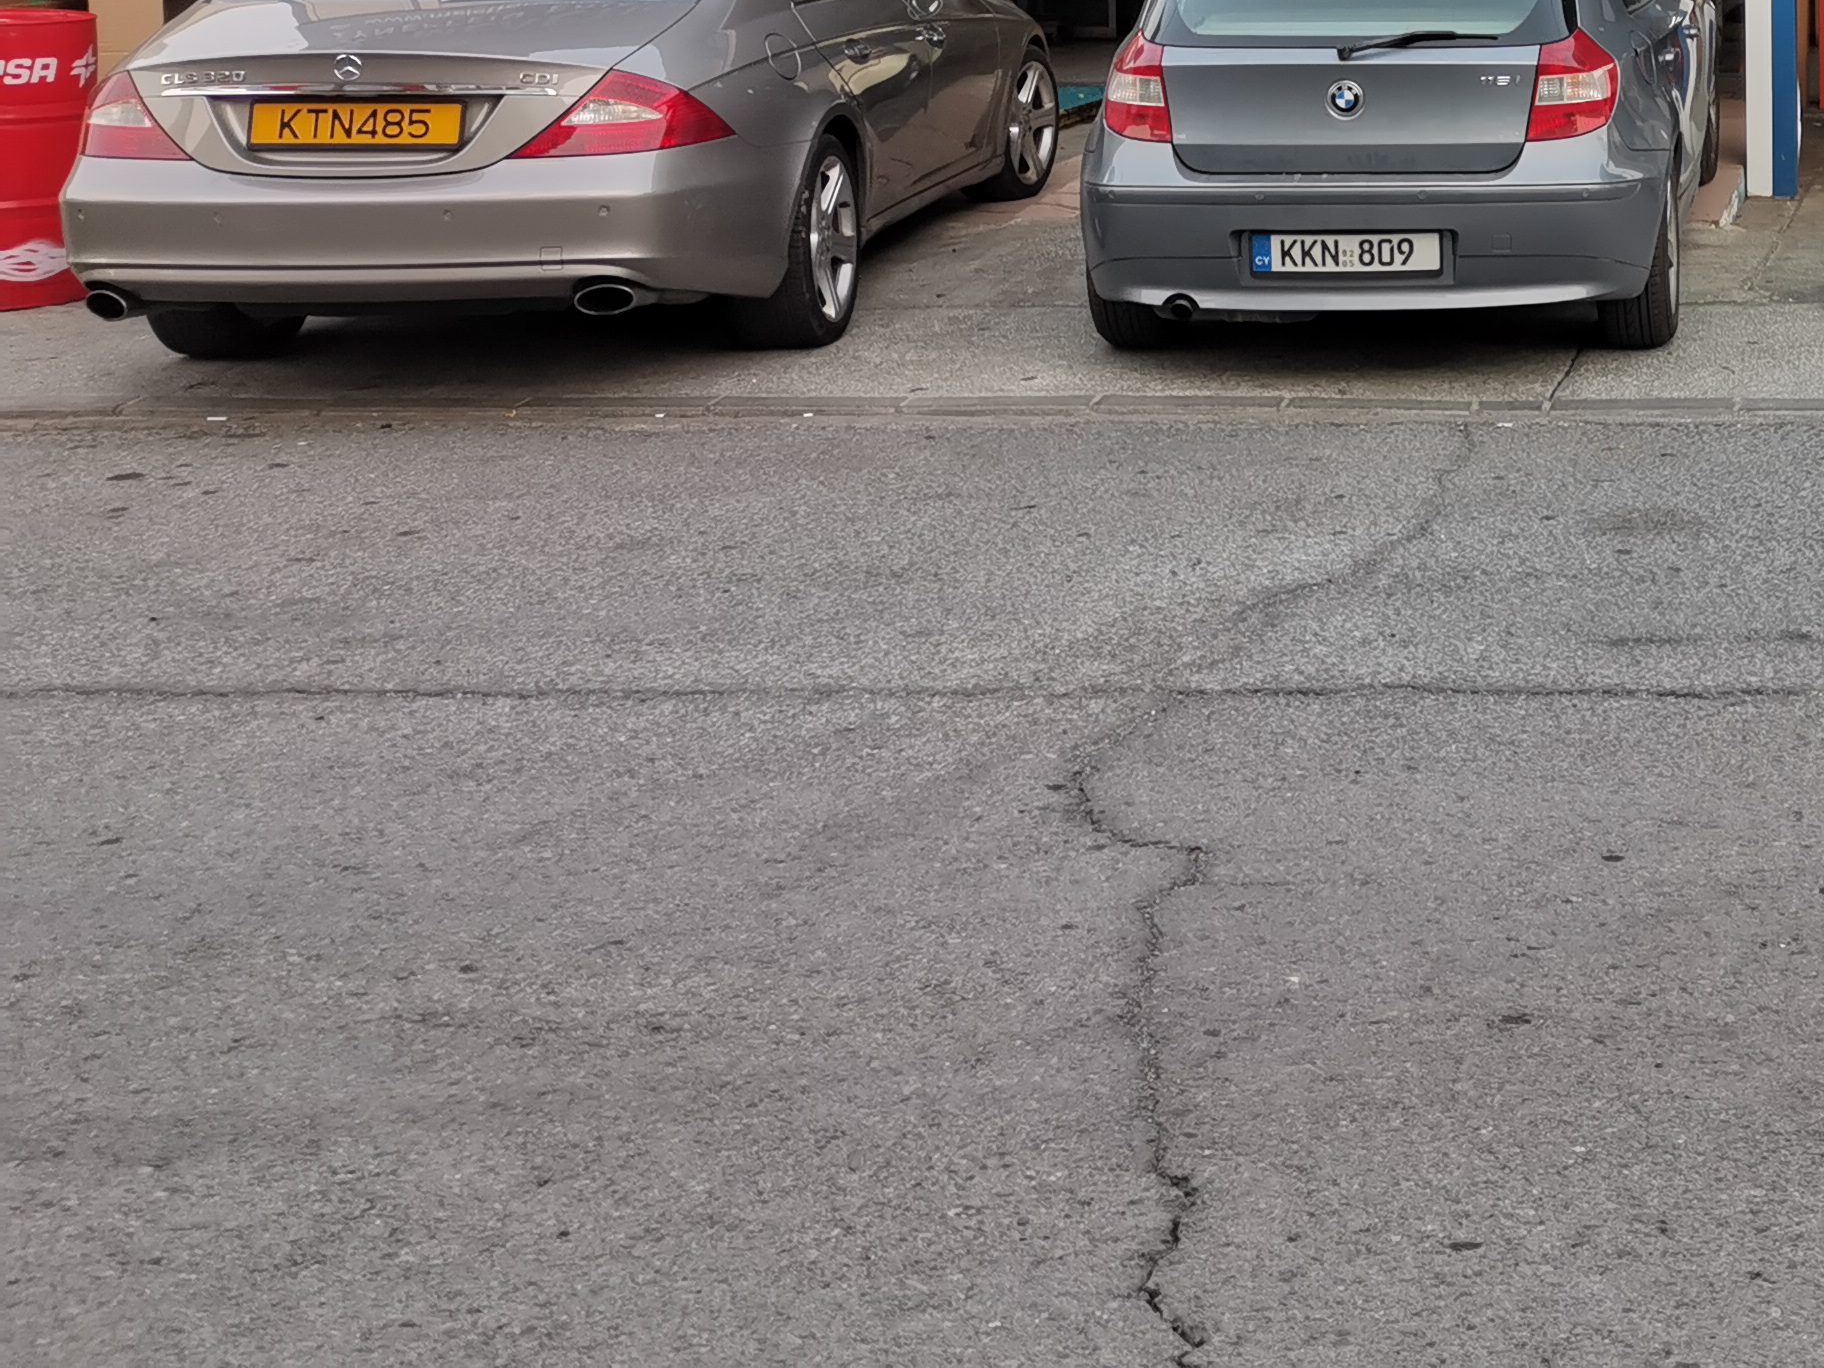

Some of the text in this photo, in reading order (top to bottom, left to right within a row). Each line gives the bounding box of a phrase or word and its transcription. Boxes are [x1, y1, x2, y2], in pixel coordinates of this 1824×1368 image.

[0, 57, 57, 85] SA
[161, 71, 558, 85] CLS 320 CDI
[278, 109, 432, 140] KTN485
[1255, 238, 1414, 267] CY KKN 809
